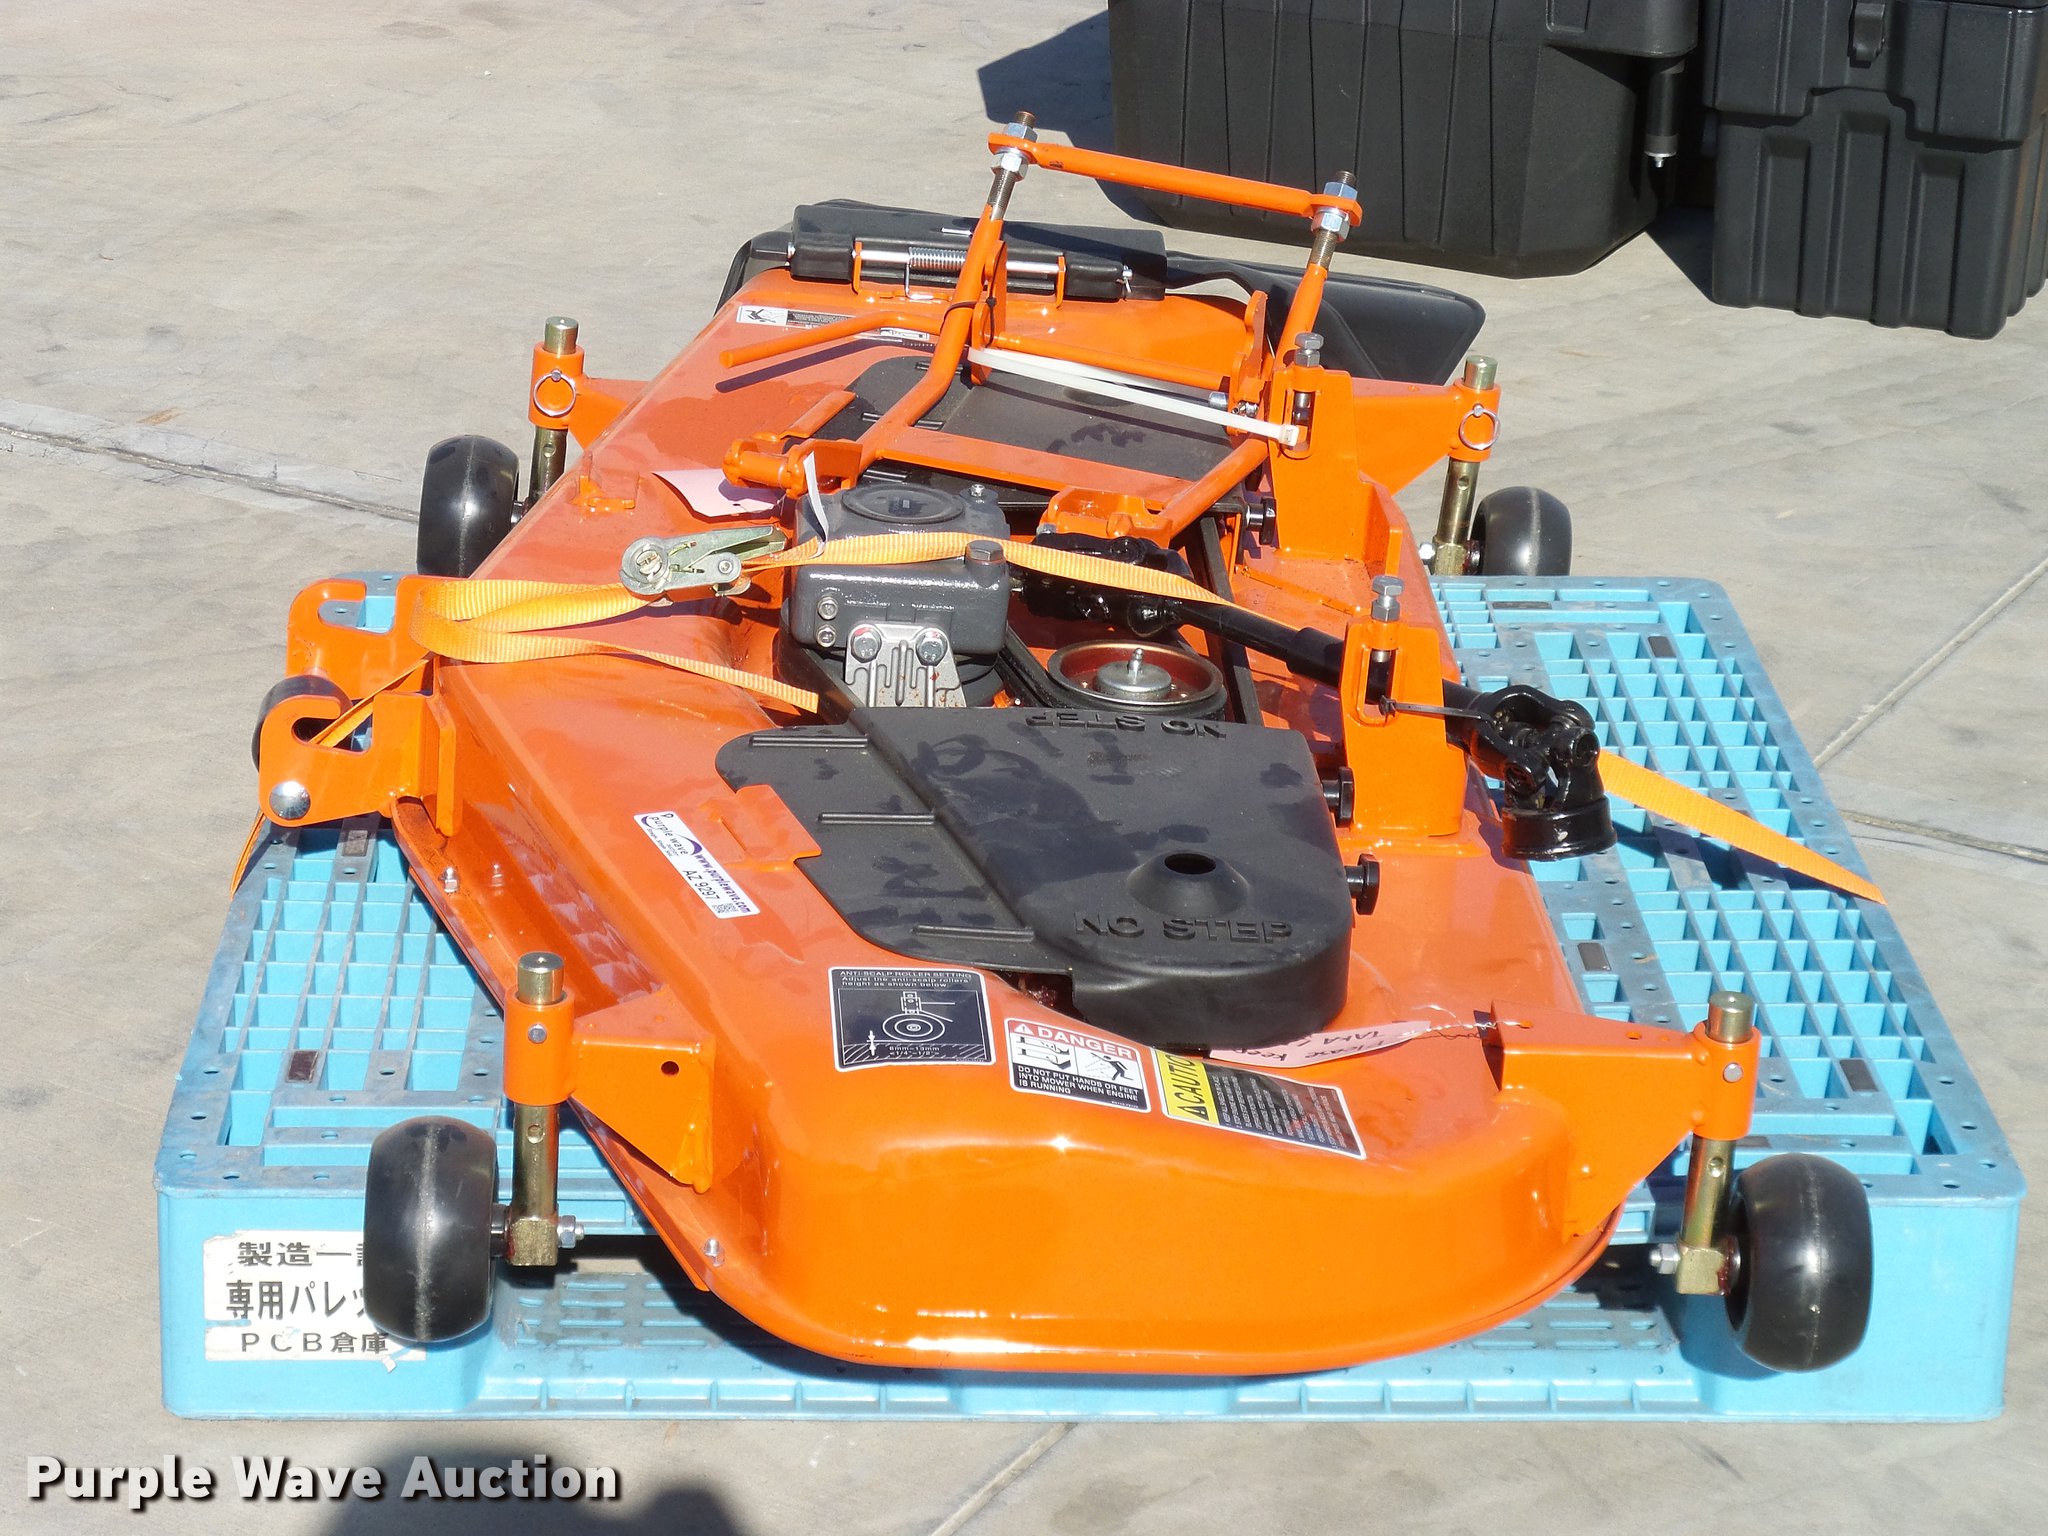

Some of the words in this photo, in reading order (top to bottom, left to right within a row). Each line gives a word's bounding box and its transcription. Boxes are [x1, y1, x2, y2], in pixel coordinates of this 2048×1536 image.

[1025, 712, 1146, 733] STEP
[1161, 719, 1227, 740] NO
[682, 870, 703, 881] AZ
[694, 882, 720, 899] 9297
[1074, 912, 1144, 938] NO
[1162, 917, 1292, 943] STEP
[1037, 1026, 1133, 1059] DANGER
[1018, 1065, 1030, 1073] DO
[1033, 1067, 1052, 1077] NOT
[1053, 1071, 1071, 1080] PUT
[1072, 1074, 1103, 1087] HANDS
[1104, 1080, 1117, 1090] OR
[1119, 1084, 1139, 1095] FEET
[1018, 1072, 1039, 1082] INTO
[1041, 1076, 1076, 1088] MOWER
[1077, 1082, 1105, 1094] WHEN
[1107, 1088, 1138, 1101] ENGINE
[1019, 1079, 1028, 1087] IS
[1030, 1081, 1071, 1094] RUNNING
[1165, 1054, 1206, 1104] CAUTIO
[226, 1279, 364, 1320] 専用パレッ
